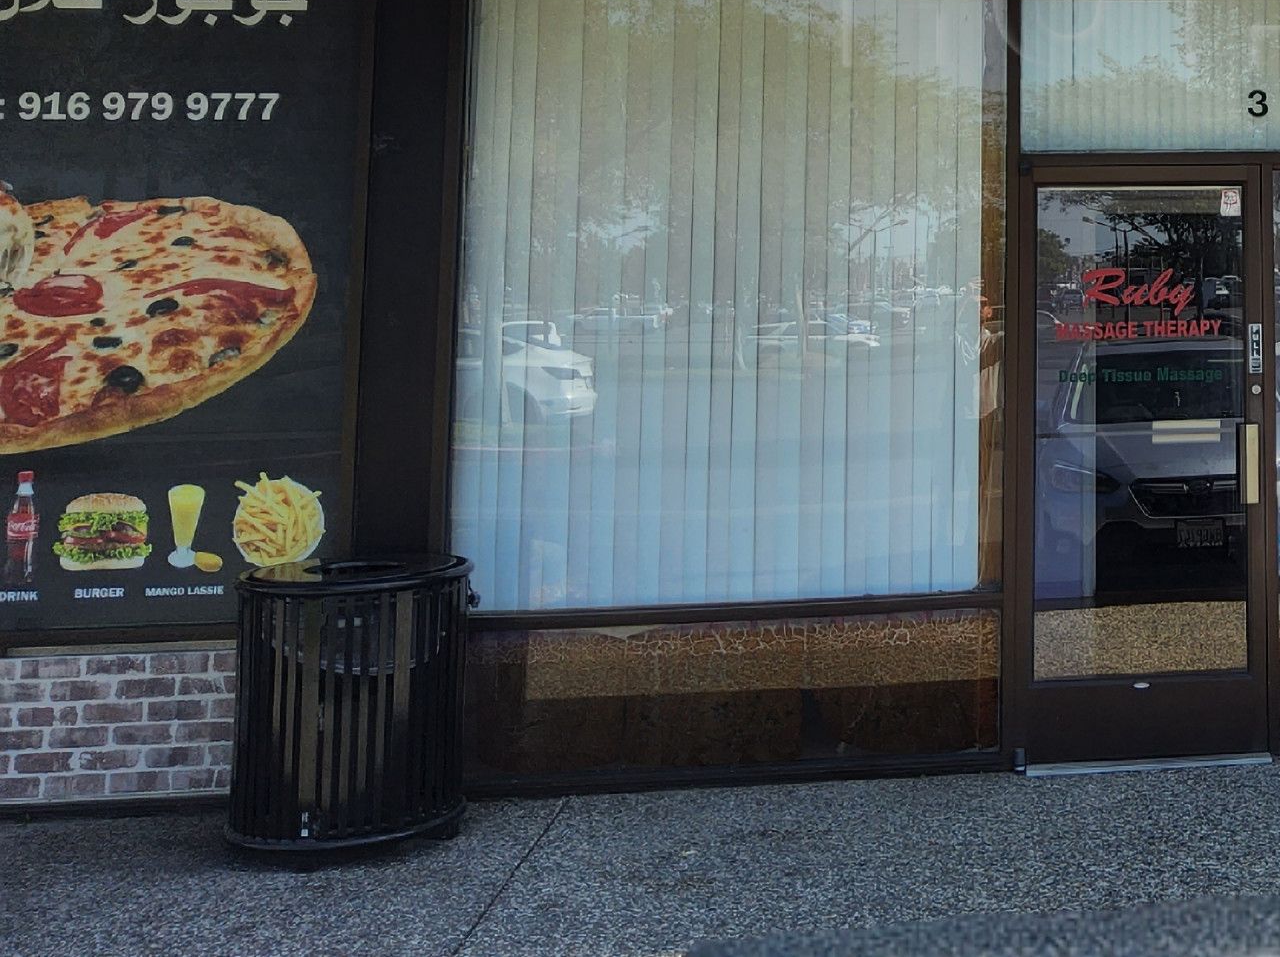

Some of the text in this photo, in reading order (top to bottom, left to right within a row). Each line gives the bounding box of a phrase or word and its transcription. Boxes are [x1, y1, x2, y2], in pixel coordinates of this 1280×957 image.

[18, 91, 91, 121] 916
[102, 91, 174, 121] 979
[186, 91, 280, 121] 9777
[1247, 89, 1269, 118] 3
[1082, 267, 1196, 317] Ruby
[1056, 319, 1222, 341] MASSAGE THERAPY
[1059, 367, 1223, 385] Deep Tissue Massage
[74, 587, 125, 599] BURGER
[145, 585, 224, 596] MANGO LASSIE
